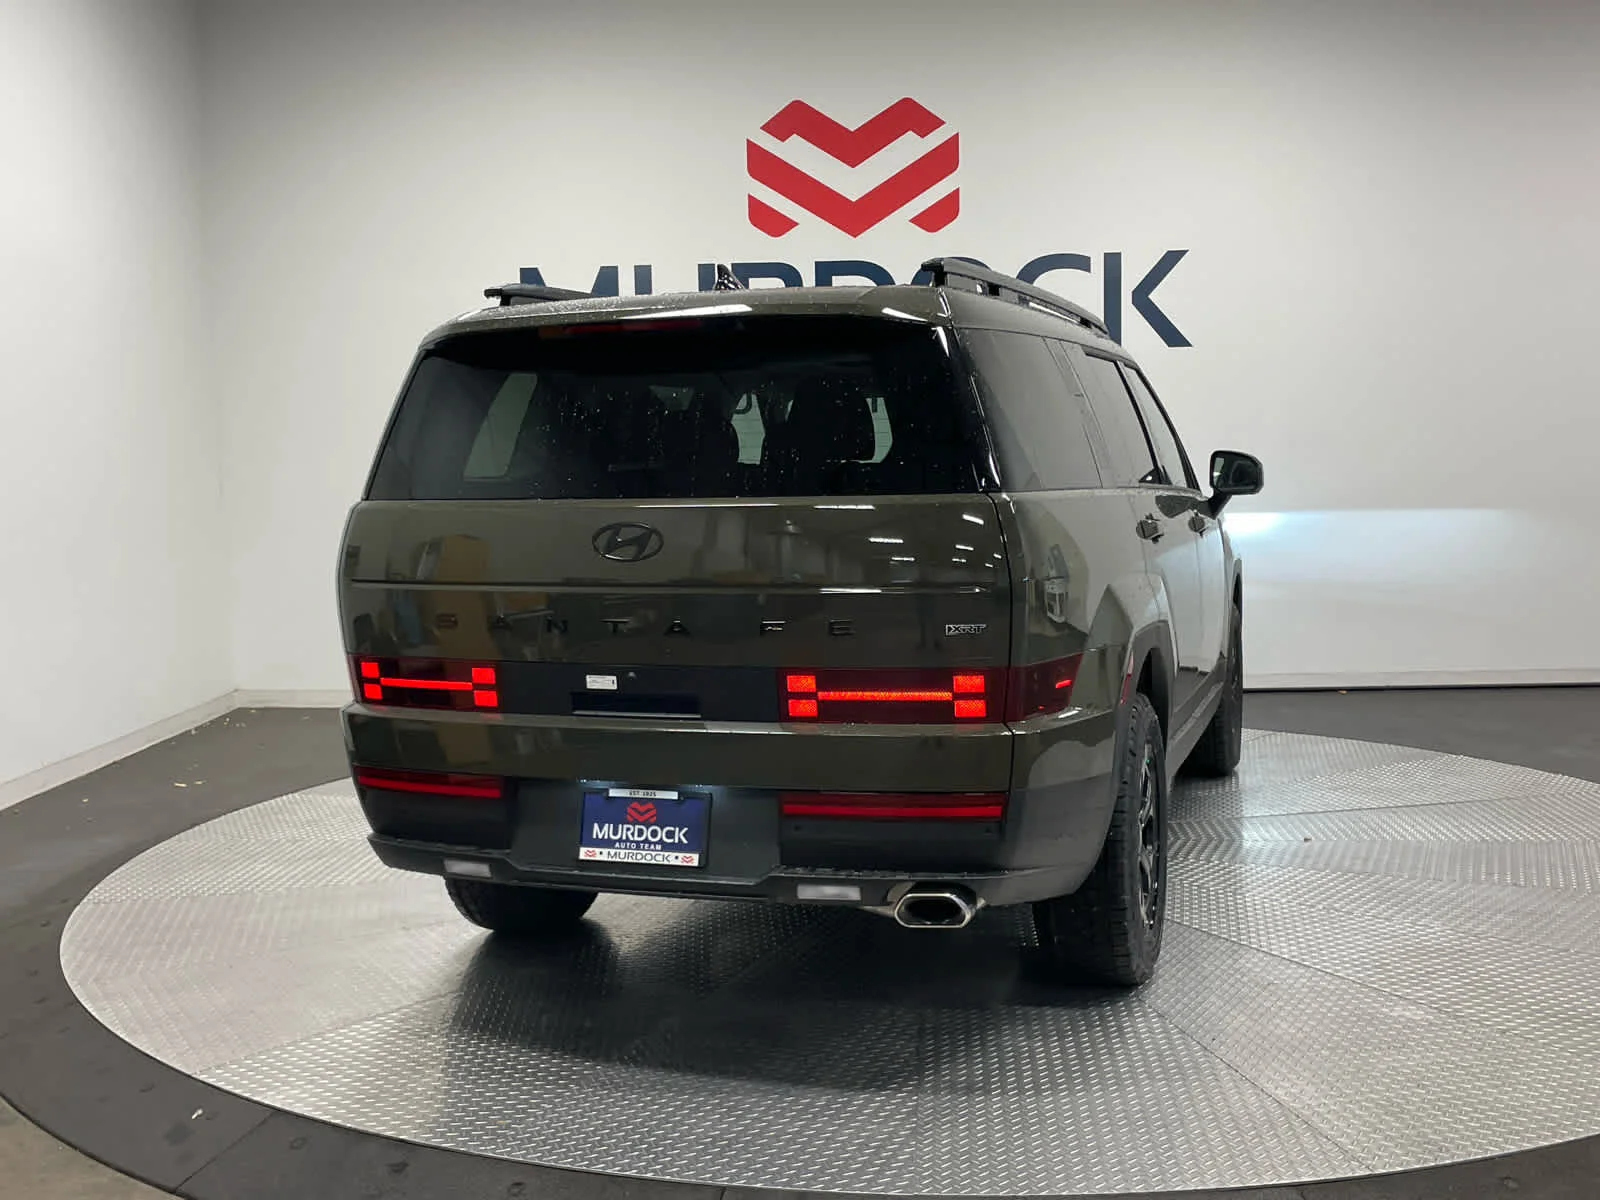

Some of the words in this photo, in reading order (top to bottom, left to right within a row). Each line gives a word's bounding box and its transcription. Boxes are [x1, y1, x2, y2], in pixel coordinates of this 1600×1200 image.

[436, 614, 692, 636] SANTA
[758, 617, 855, 637] FE
[945, 623, 987, 636] XRT
[592, 822, 689, 844] MURDOCK
[614, 841, 637, 850] AUTO
[640, 843, 662, 851] TEAM
[607, 850, 671, 863] MURDOCK
